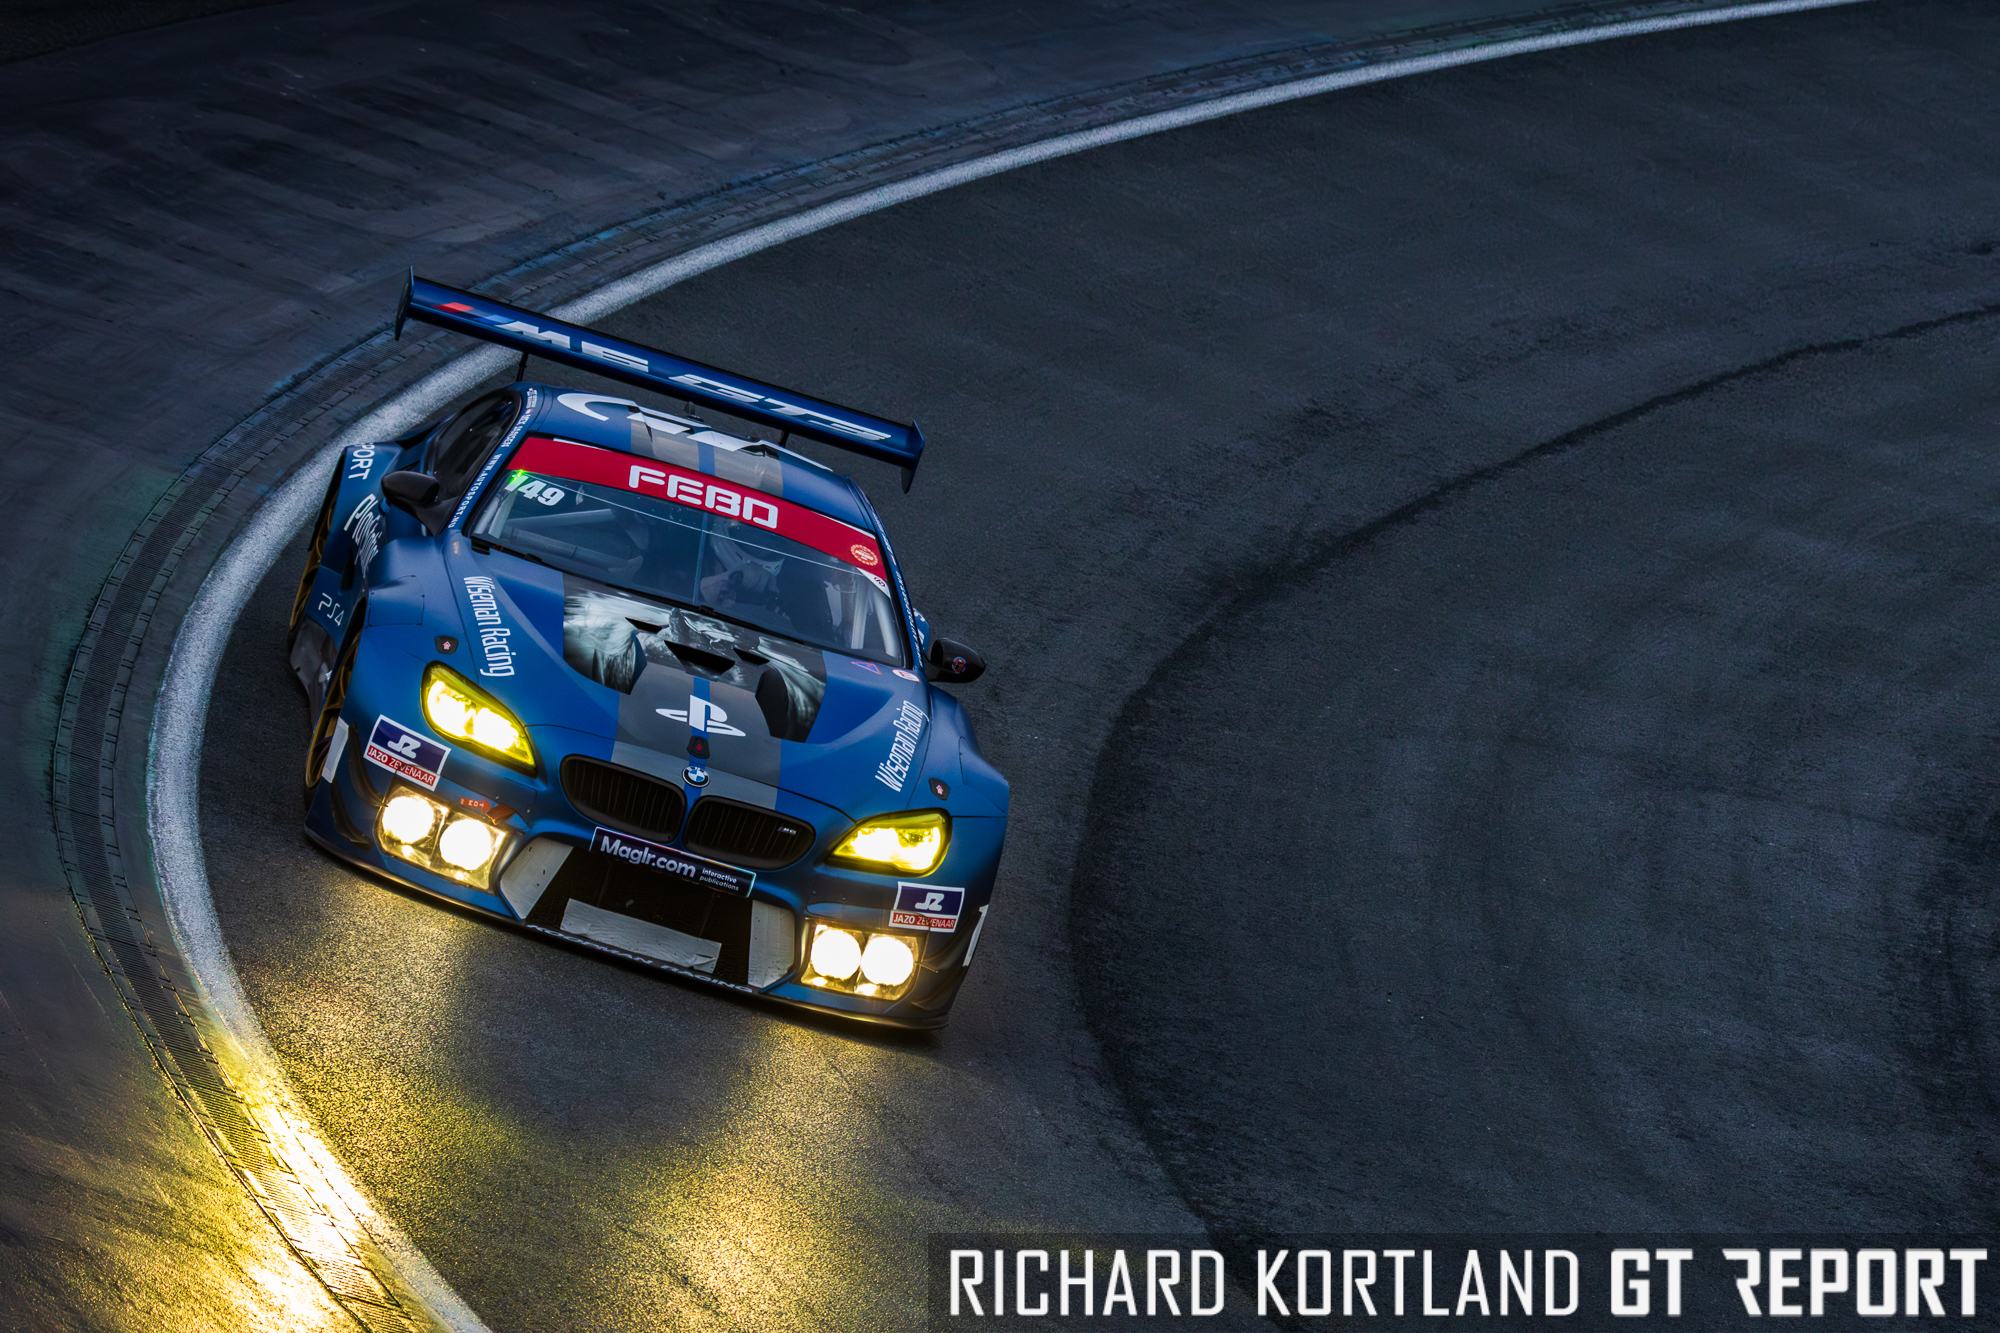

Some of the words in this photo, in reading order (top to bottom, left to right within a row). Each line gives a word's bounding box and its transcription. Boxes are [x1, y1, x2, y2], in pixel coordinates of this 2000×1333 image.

[504, 474, 565, 506] 149
[628, 465, 778, 529] FEBO
[318, 592, 345, 627] PS4
[463, 575, 502, 627] Wiseman
[480, 628, 517, 677] Racing
[892, 700, 930, 740] Racing
[368, 747, 388, 763] JAZO
[388, 757, 434, 785] ZEVENAAR
[874, 730, 918, 793] Wiseman
[600, 835, 697, 878] Maglr.com
[702, 867, 737, 884] interactive
[699, 875, 739, 892] publications
[893, 913, 916, 925] JAZO
[916, 916, 955, 928] ZEVENAAR
[660, 964, 752, 993] RACING
